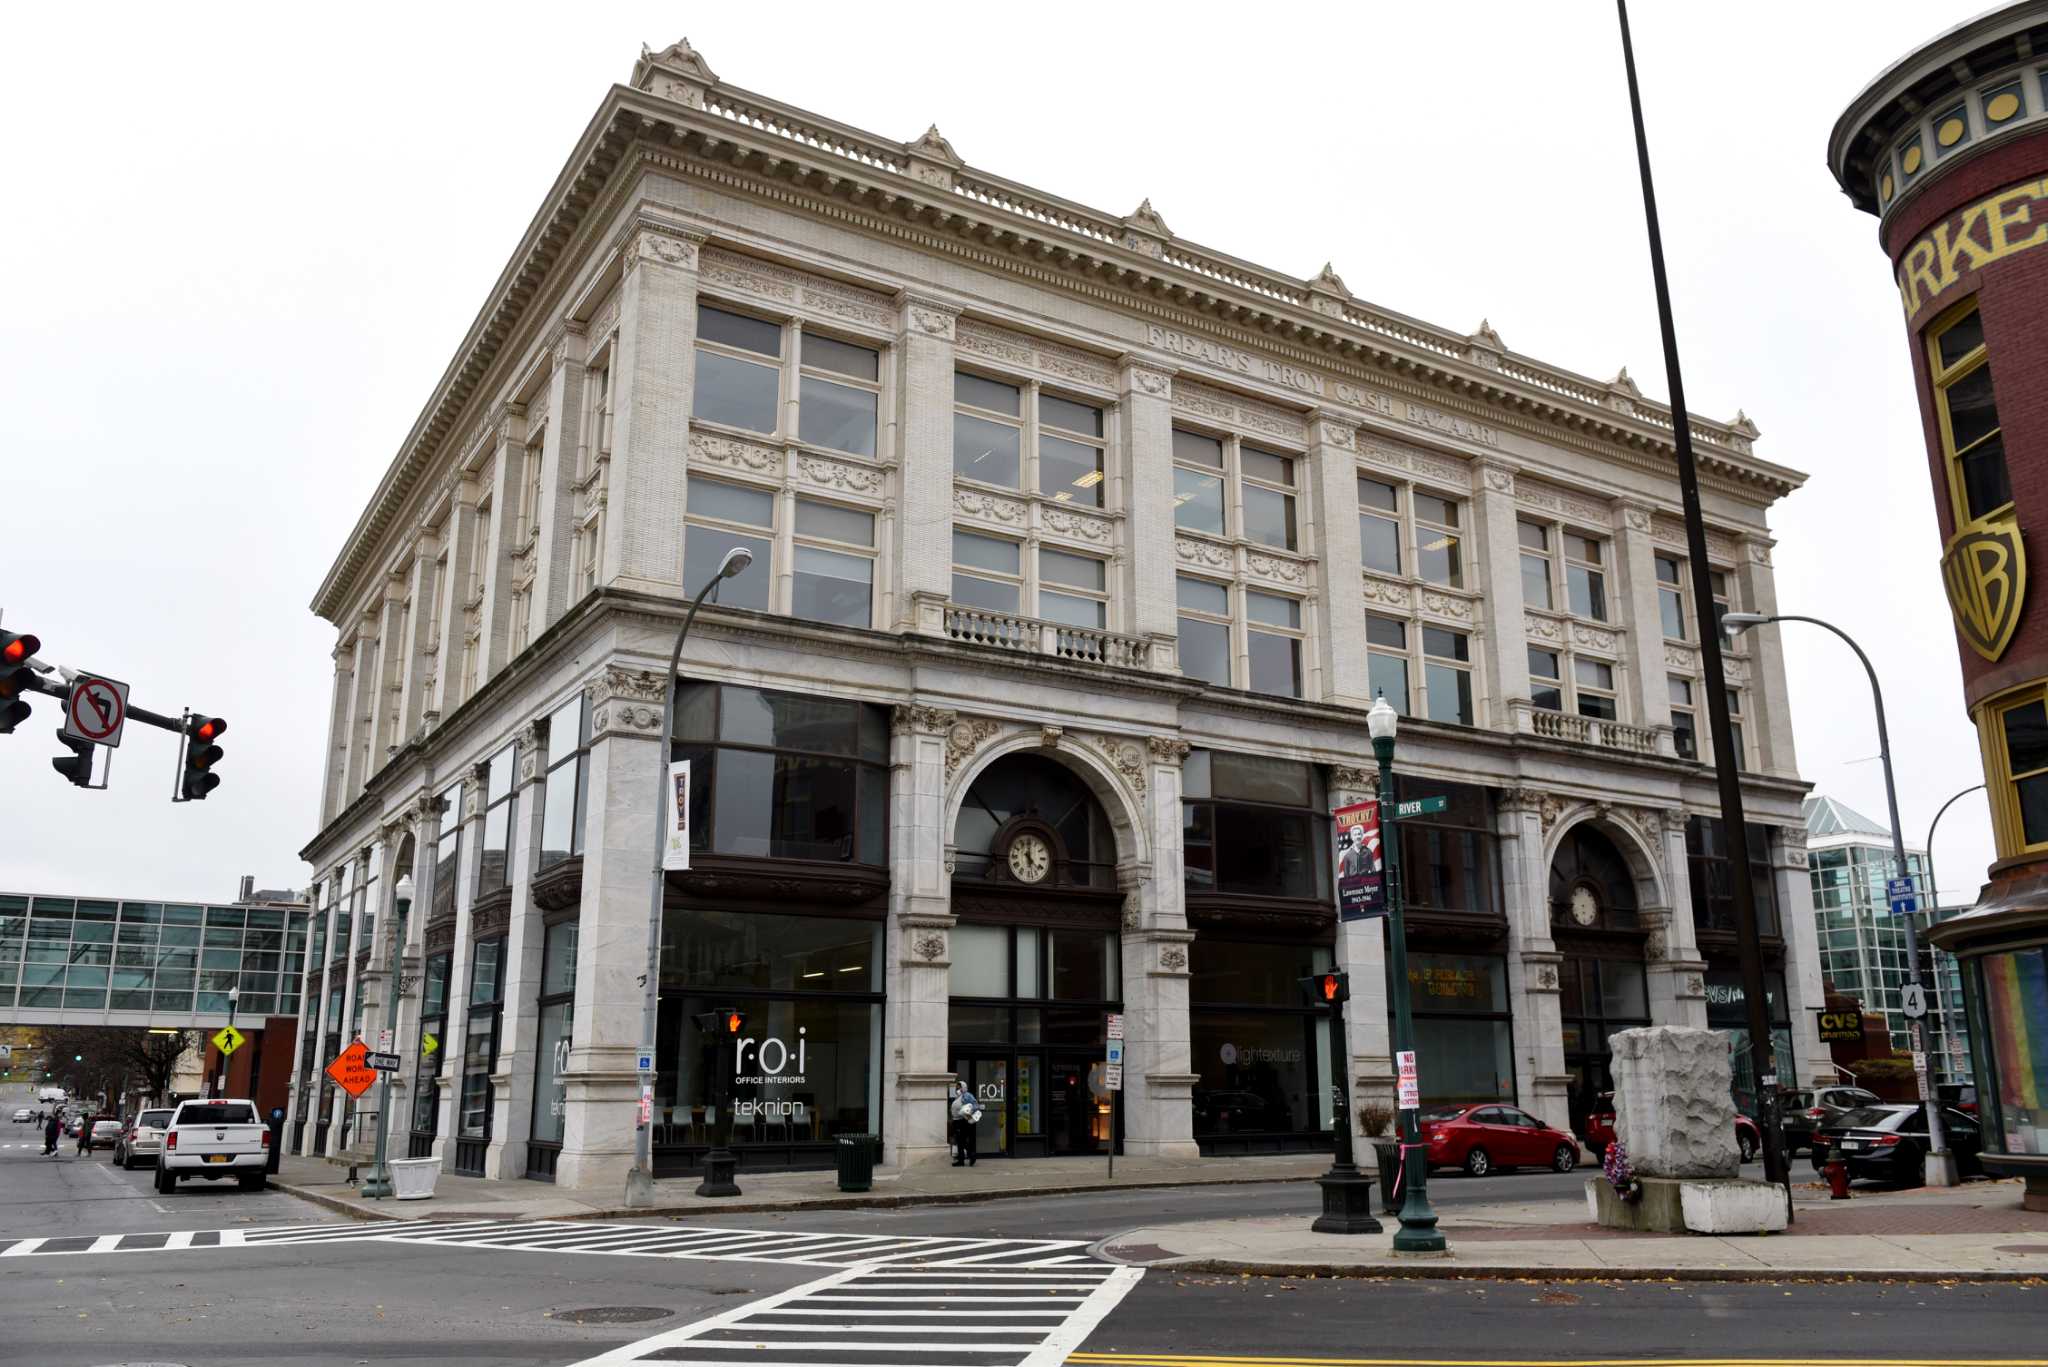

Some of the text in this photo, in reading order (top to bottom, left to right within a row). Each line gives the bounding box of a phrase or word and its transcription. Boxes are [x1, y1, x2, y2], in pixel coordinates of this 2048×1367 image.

[1145, 323, 1250, 372] FREAR'S
[1264, 360, 1323, 396] TROY
[1335, 382, 1394, 416] CASH
[1946, 541, 2010, 641] WB
[1398, 801, 1422, 815] RIVER
[1907, 991, 1918, 1010] 4
[1821, 1013, 1858, 1029] CVS
[1403, 1053, 1414, 1063] NO
[343, 1075, 370, 1083] AHEAD
[735, 1076, 806, 1085] OFFICE INTERIORS
[734, 1097, 804, 1116] teknion
